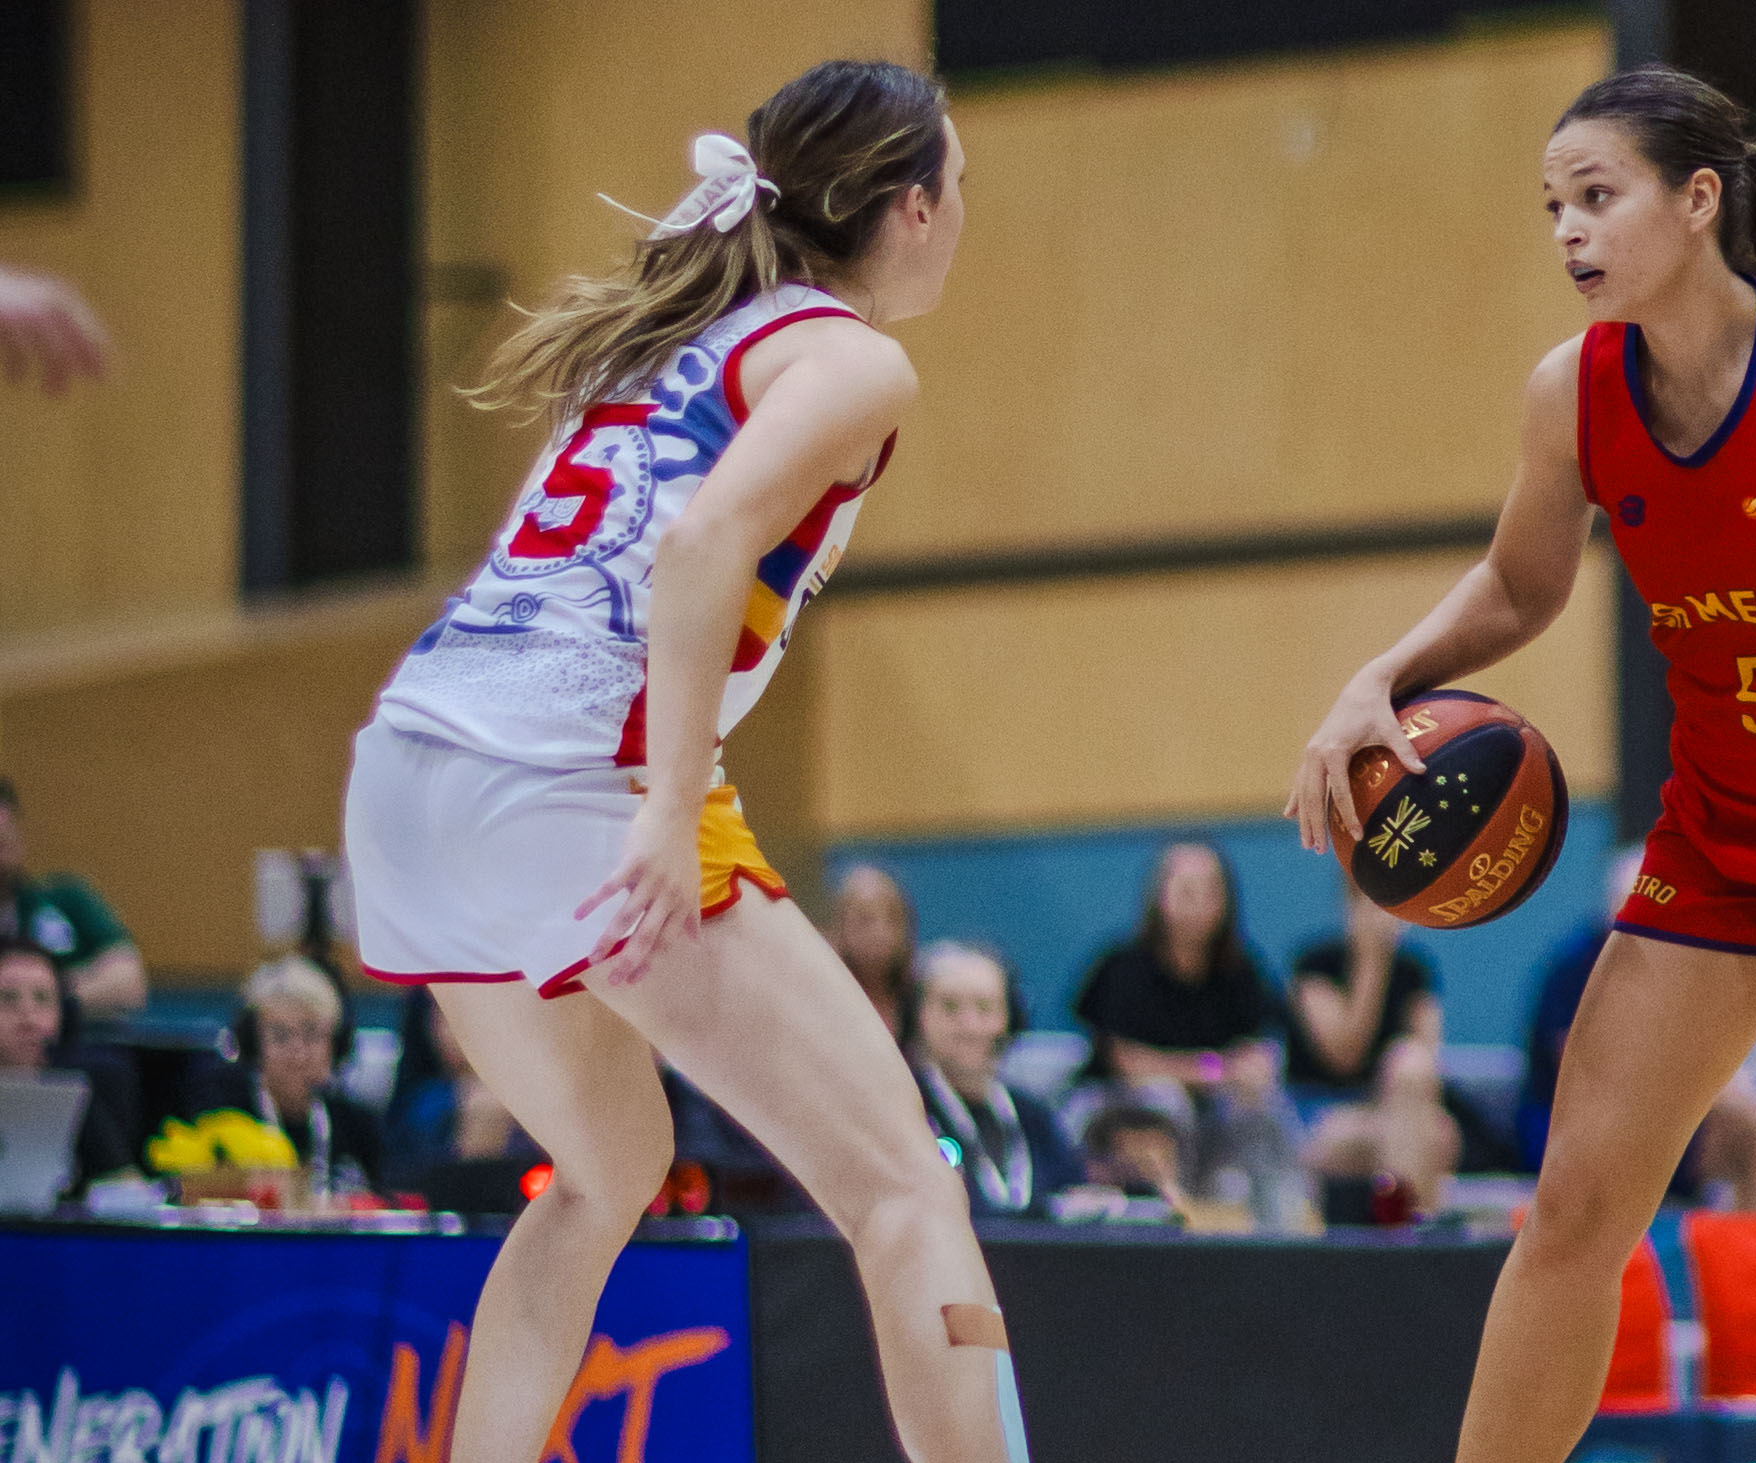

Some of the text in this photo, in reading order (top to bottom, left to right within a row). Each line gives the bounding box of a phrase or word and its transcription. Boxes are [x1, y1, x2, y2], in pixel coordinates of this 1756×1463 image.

[508, 404, 662, 559] 5
[1428, 804, 1544, 923] SPALDING
[1632, 874, 1677, 904] TRO
